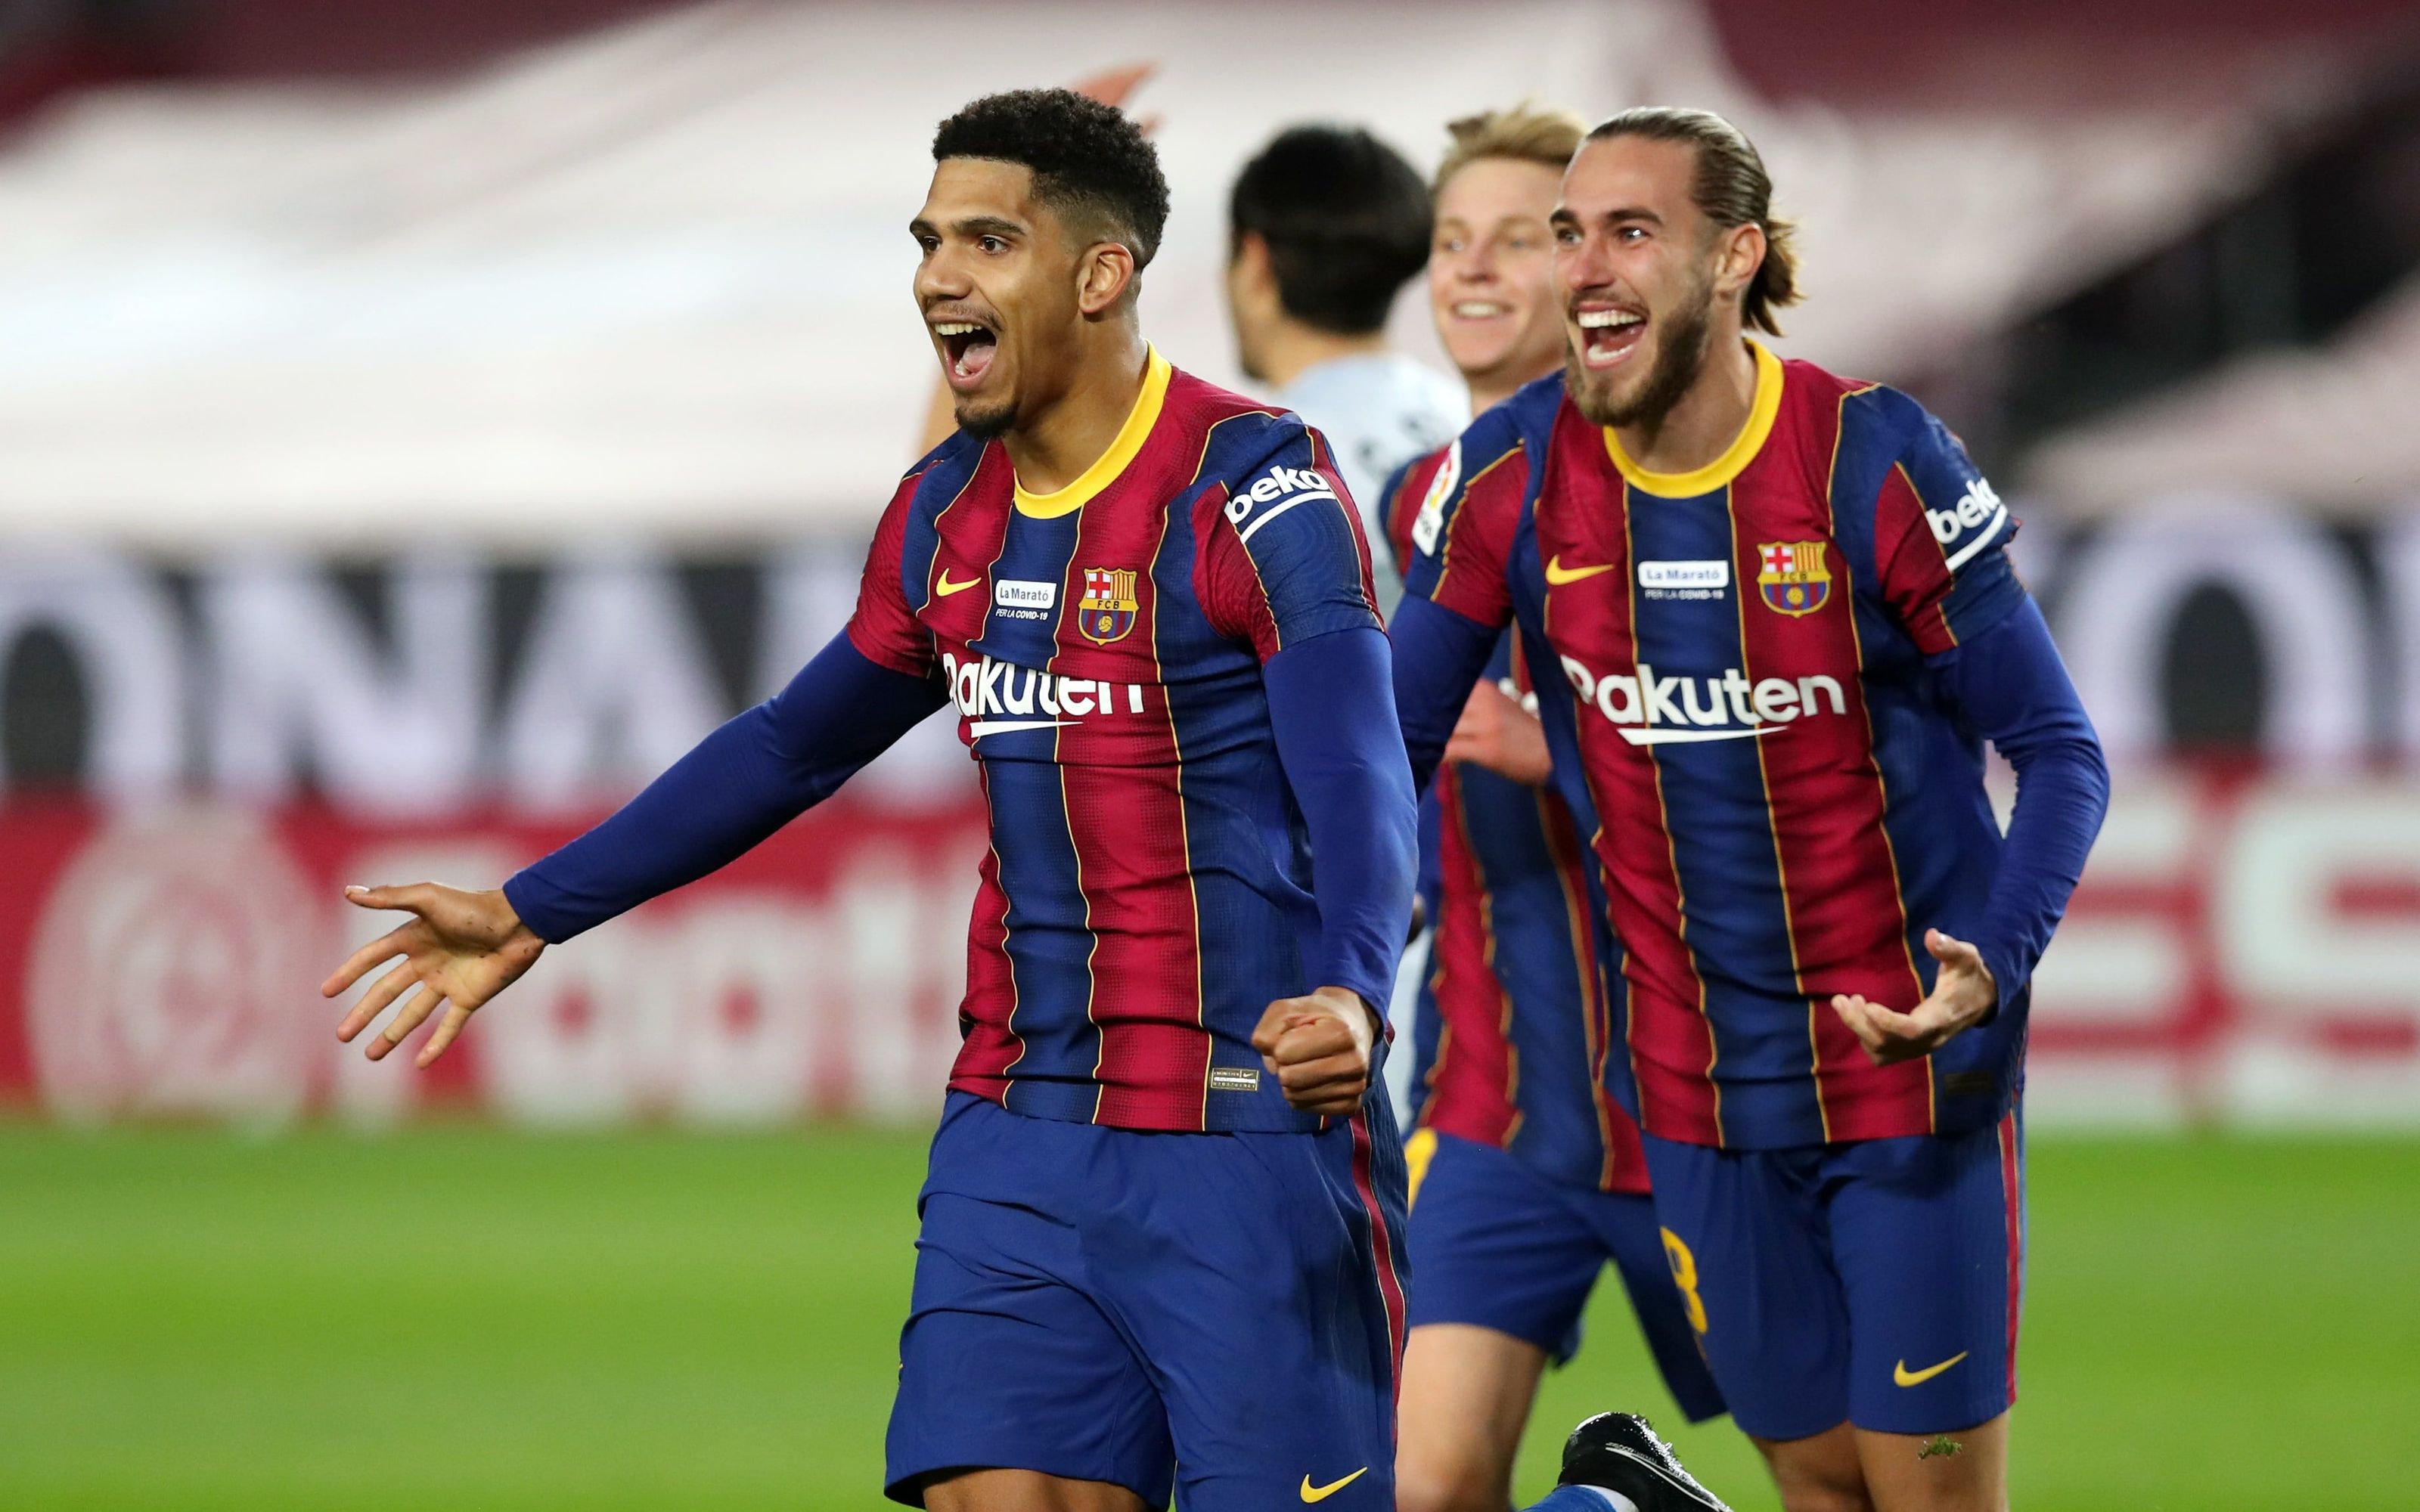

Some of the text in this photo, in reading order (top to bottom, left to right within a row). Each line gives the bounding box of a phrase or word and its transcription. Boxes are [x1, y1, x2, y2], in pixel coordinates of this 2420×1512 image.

[1224, 465, 1330, 524] beko
[1646, 567, 1721, 581] La Marató
[1000, 587, 1049, 601] La Marató
[1097, 600, 1120, 609] FCB
[995, 608, 1048, 621] PER LA COVID-19
